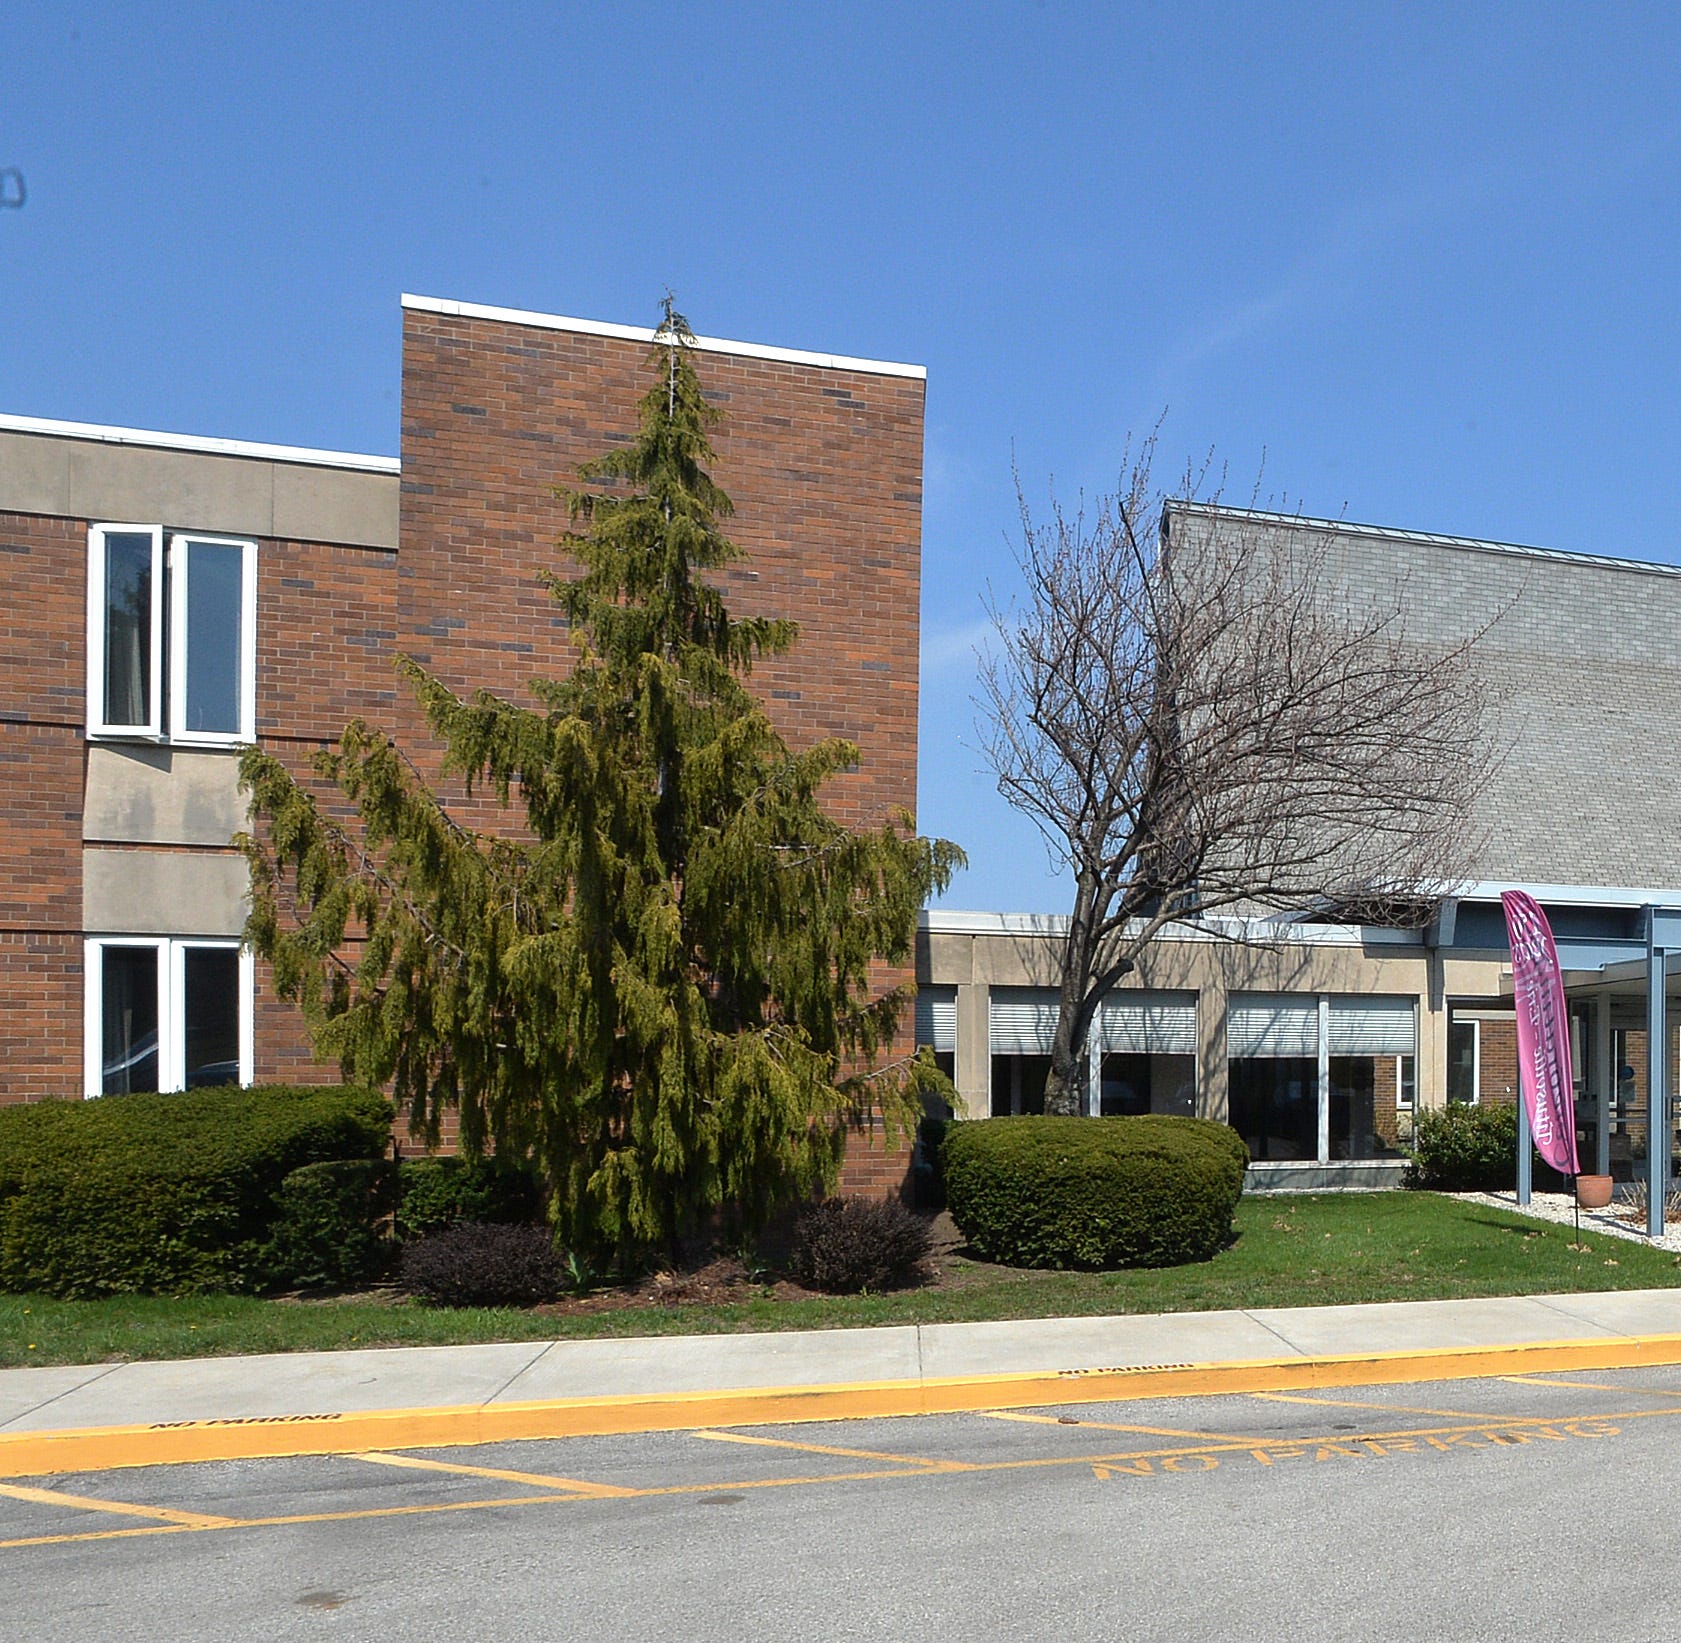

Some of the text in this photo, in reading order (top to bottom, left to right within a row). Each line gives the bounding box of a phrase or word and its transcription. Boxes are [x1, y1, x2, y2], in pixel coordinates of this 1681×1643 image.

[1057, 1363, 1195, 1376] NO PARKING
[149, 1420, 197, 1430] NO
[1090, 1422, 1622, 1480] NO PARKING
